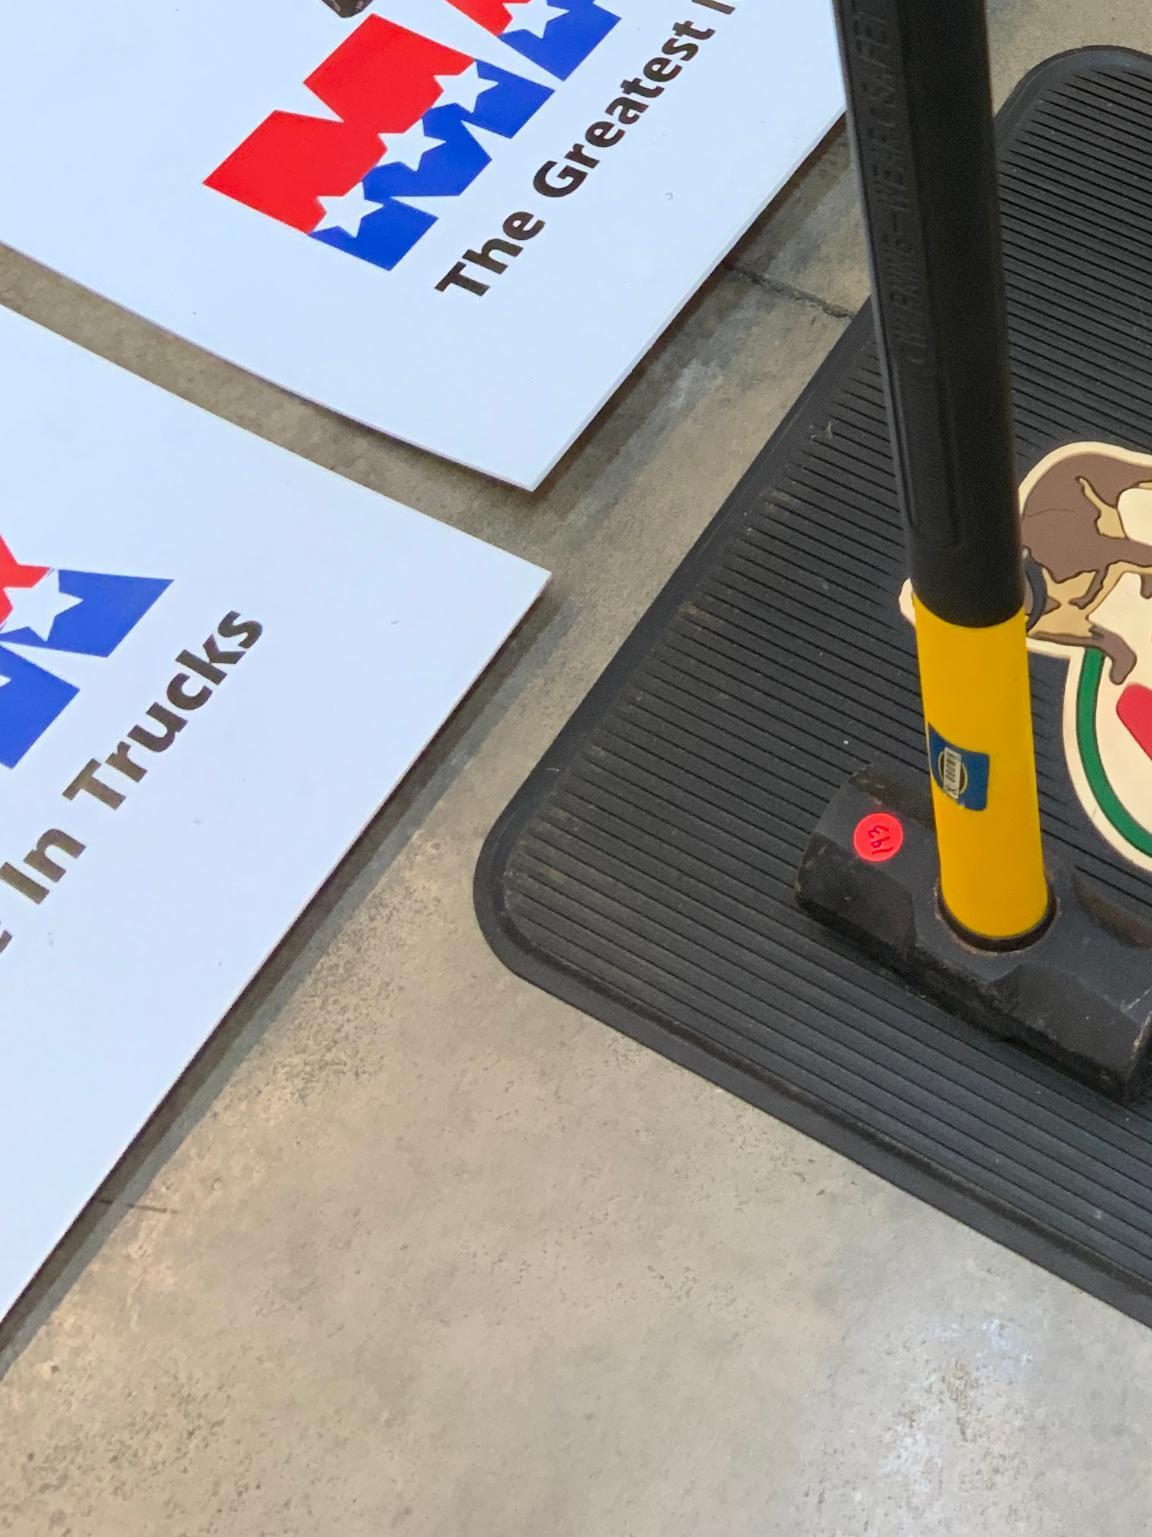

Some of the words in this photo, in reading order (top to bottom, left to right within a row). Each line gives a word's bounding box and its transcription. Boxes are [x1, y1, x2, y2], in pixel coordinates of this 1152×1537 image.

[435, 209, 545, 297] The
[532, 10, 716, 201] Greatest
[0, 826, 86, 904] In
[61, 609, 264, 811] Trucks
